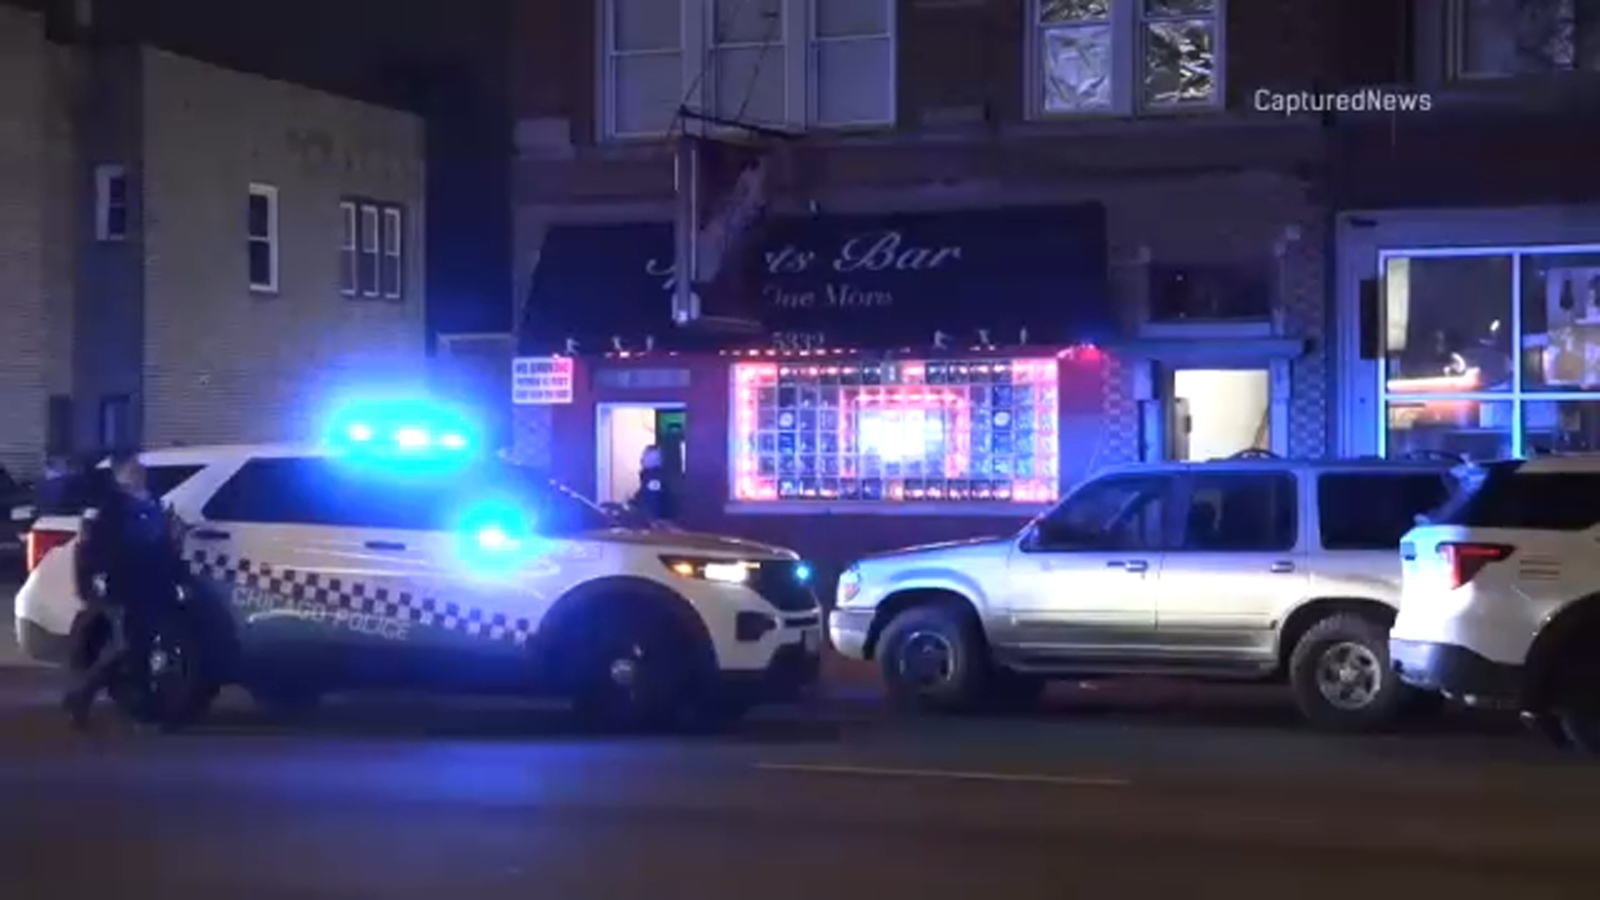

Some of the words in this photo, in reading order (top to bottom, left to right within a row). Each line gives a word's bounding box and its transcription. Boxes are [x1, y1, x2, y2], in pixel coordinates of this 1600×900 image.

[832, 231, 962, 273] Bar
[825, 282, 893, 308] More
[232, 586, 326, 622] CHICAGO
[331, 608, 411, 641] POLICE
